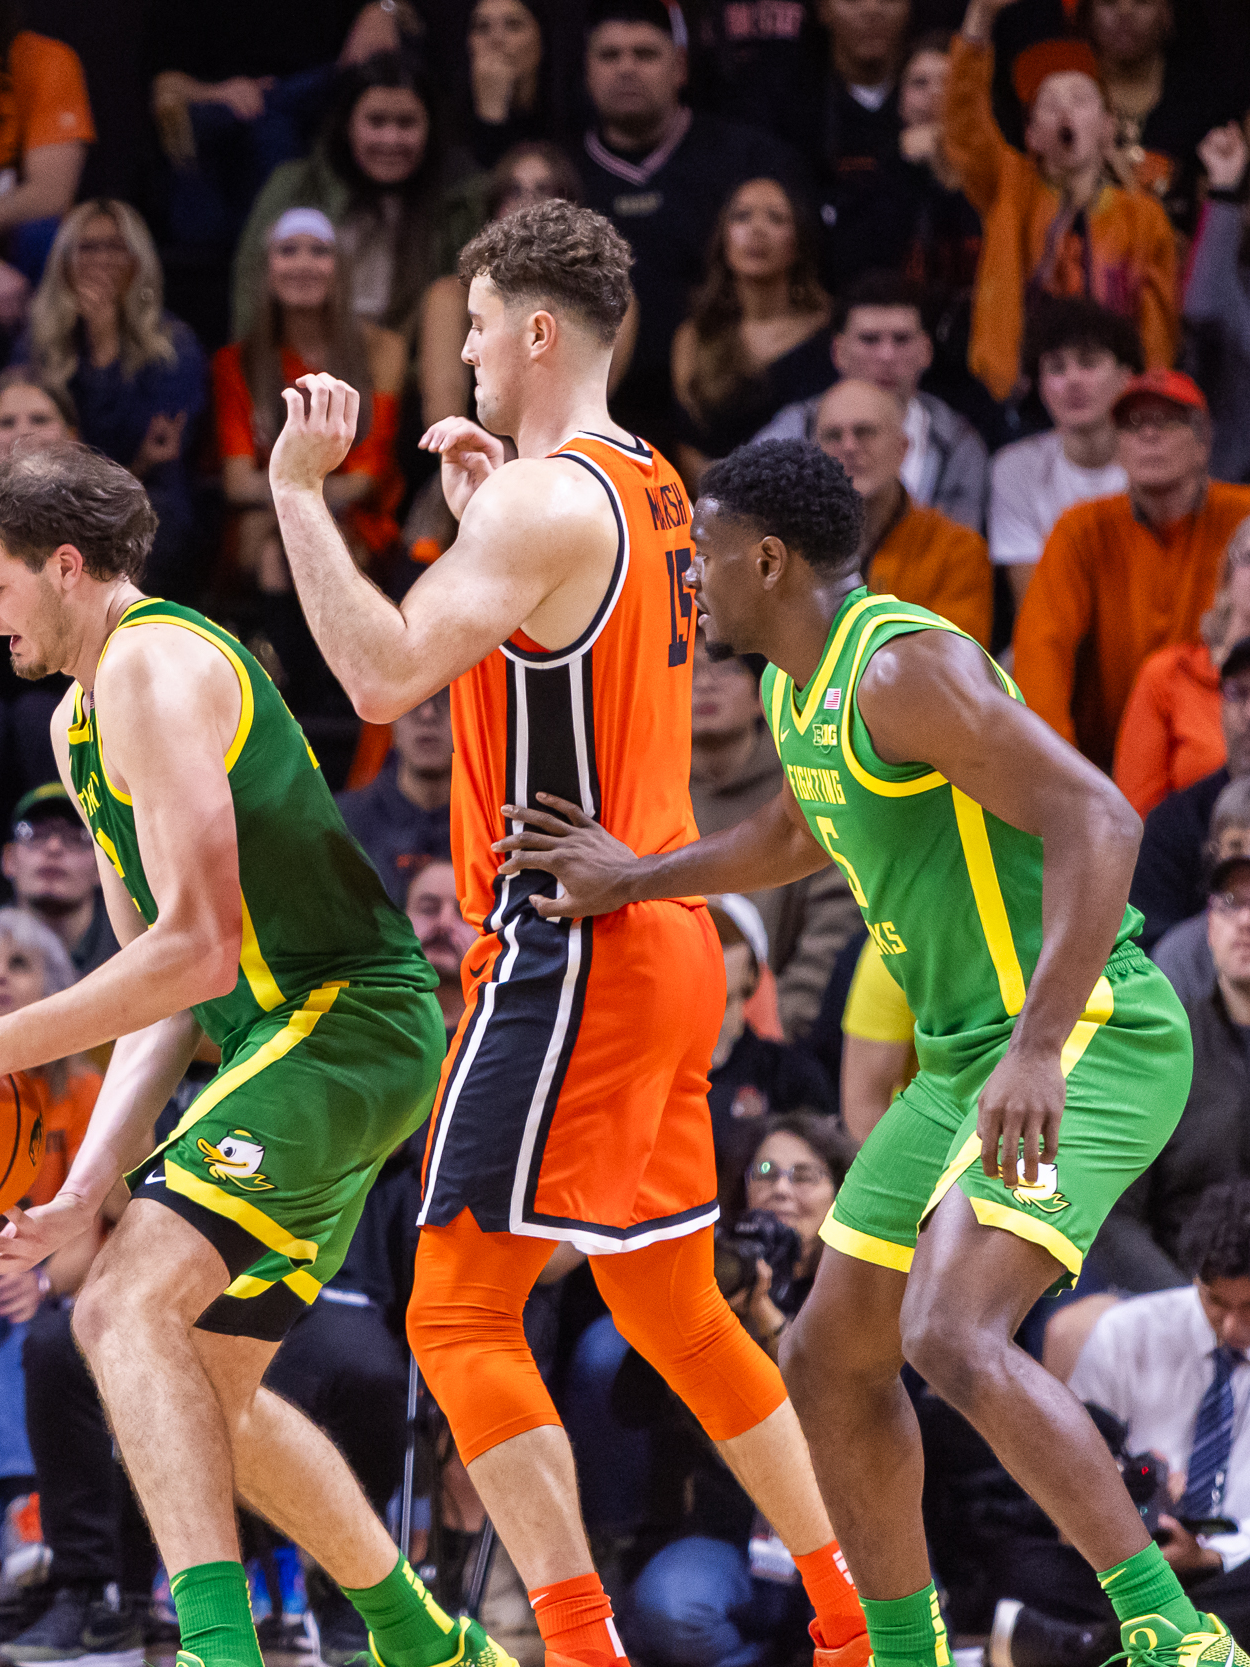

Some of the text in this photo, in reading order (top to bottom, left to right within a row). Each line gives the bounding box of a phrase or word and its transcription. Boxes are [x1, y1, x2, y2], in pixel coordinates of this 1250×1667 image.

[665, 547, 693, 668] 15
[786, 763, 847, 805] FIGHTING
[816, 815, 869, 908] 5
